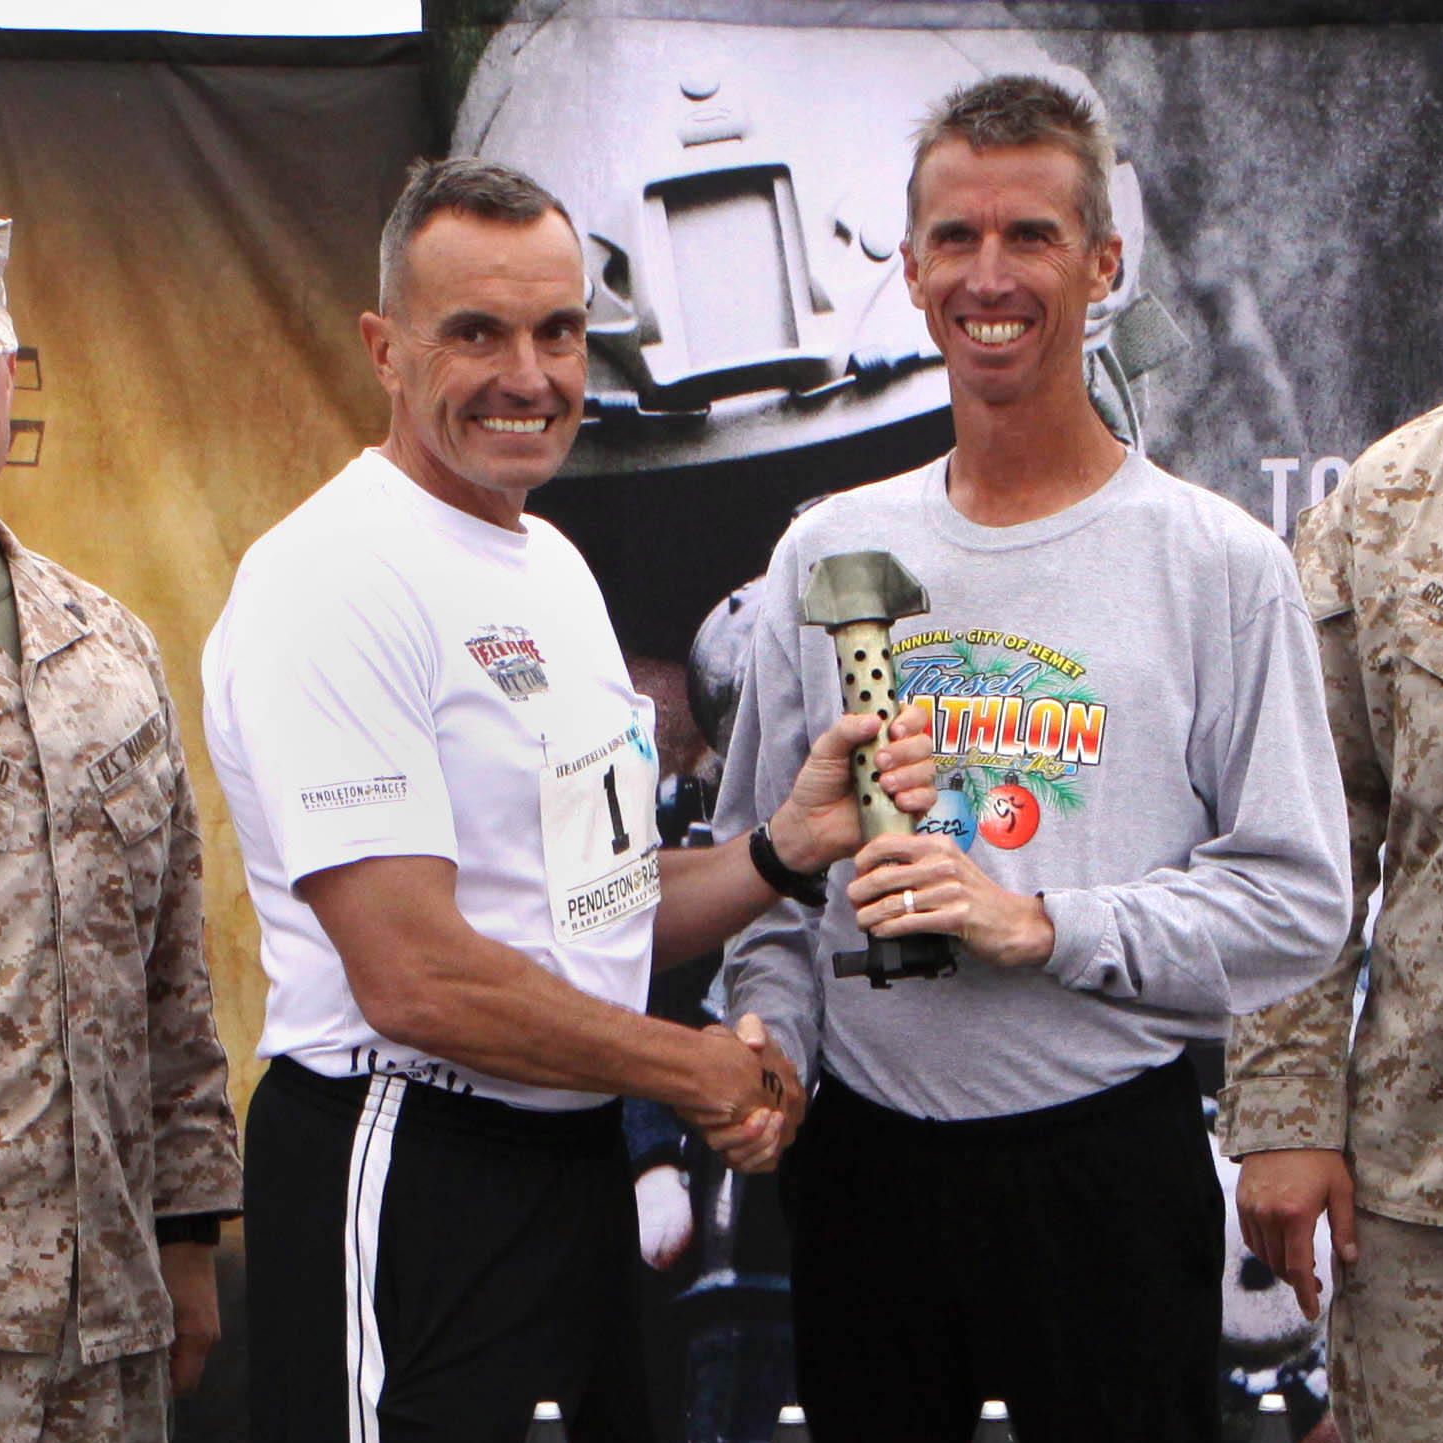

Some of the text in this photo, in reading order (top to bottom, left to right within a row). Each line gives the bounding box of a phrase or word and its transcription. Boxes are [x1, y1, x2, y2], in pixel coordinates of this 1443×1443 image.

[892, 628, 1086, 680] ANNUAL CITY OF HEMET
[898, 655, 1042, 702] Tinsel
[301, 785, 365, 804] PENDLETON
[373, 782, 407, 795] RACES
[603, 763, 631, 856] 1
[567, 872, 635, 921] PENDLETON
